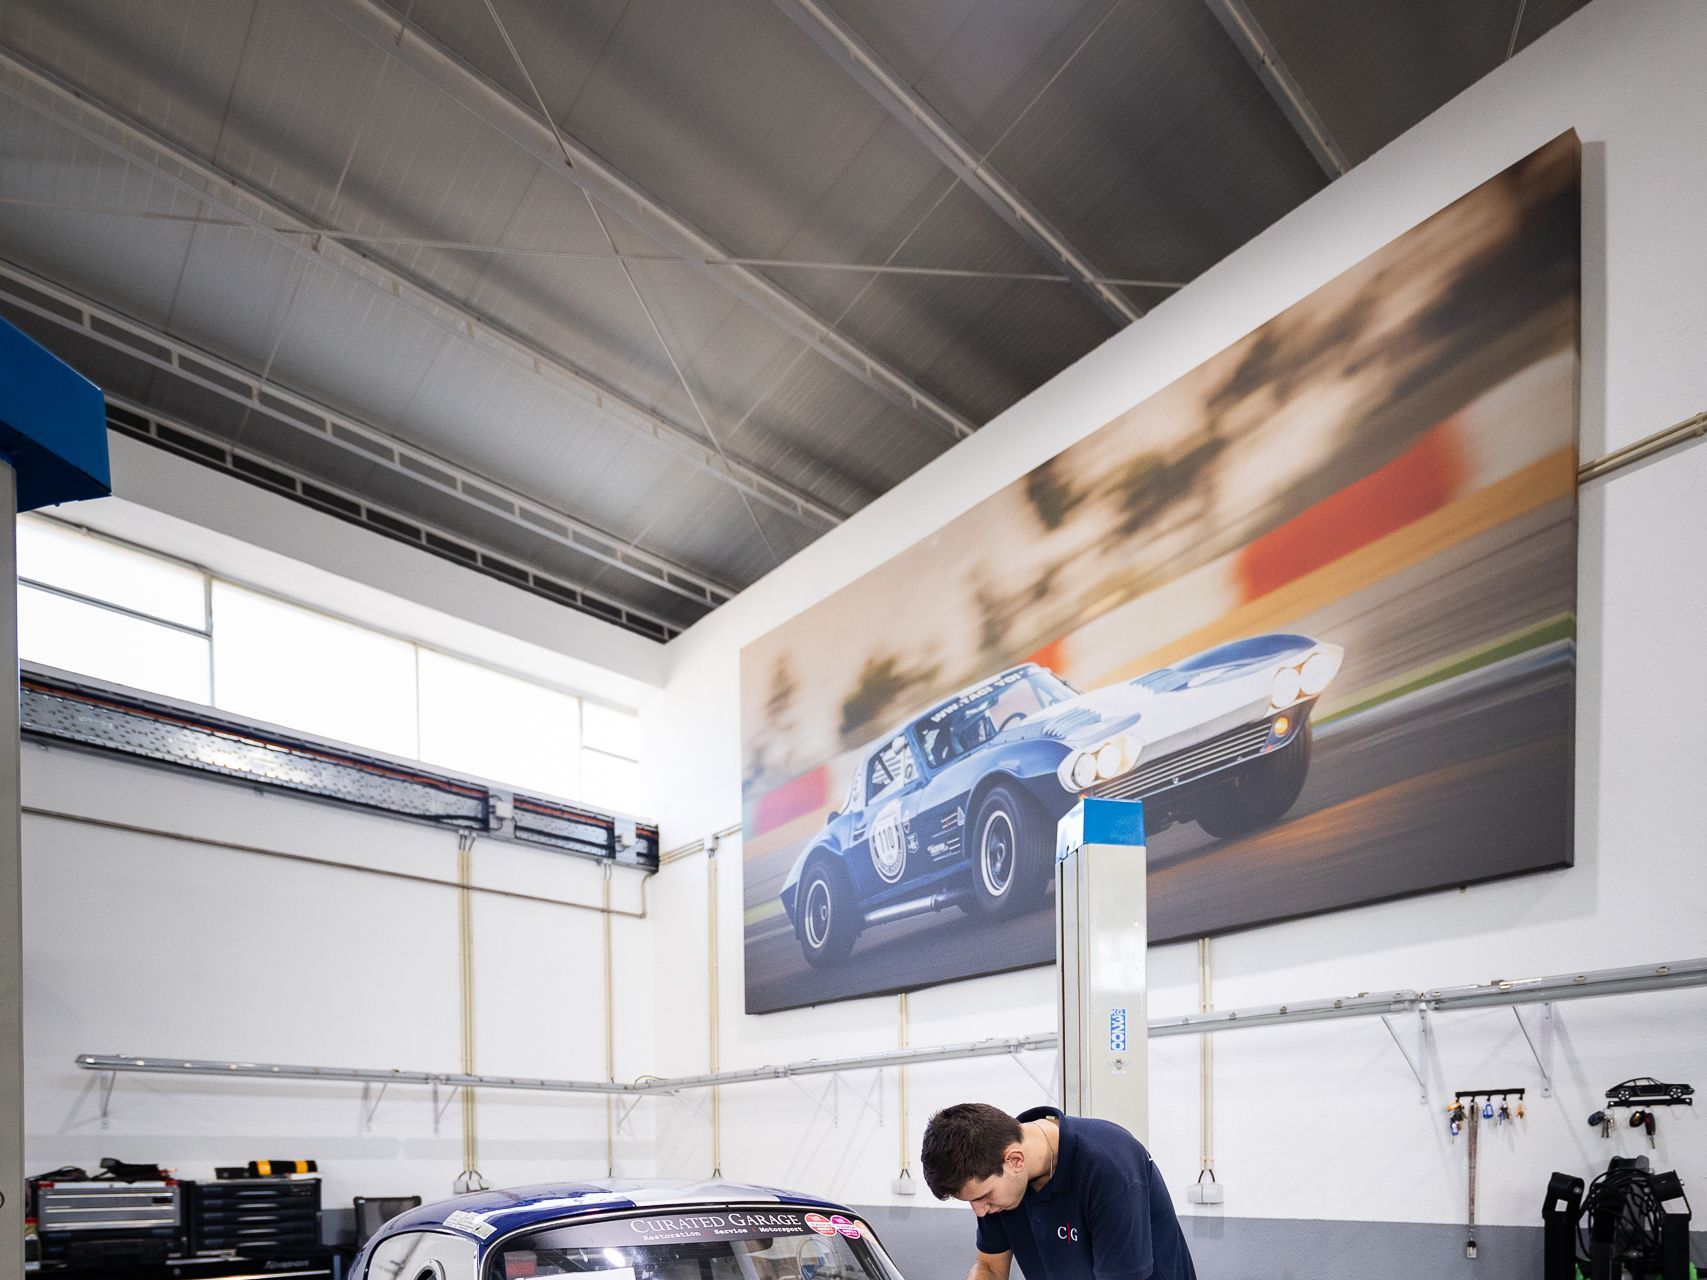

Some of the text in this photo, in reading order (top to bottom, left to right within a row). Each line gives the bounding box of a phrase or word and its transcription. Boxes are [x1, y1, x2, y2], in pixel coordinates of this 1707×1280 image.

[631, 1213, 802, 1234] CURATED GARAGE
[643, 1226, 803, 1241] Restoration Service Motorsport
